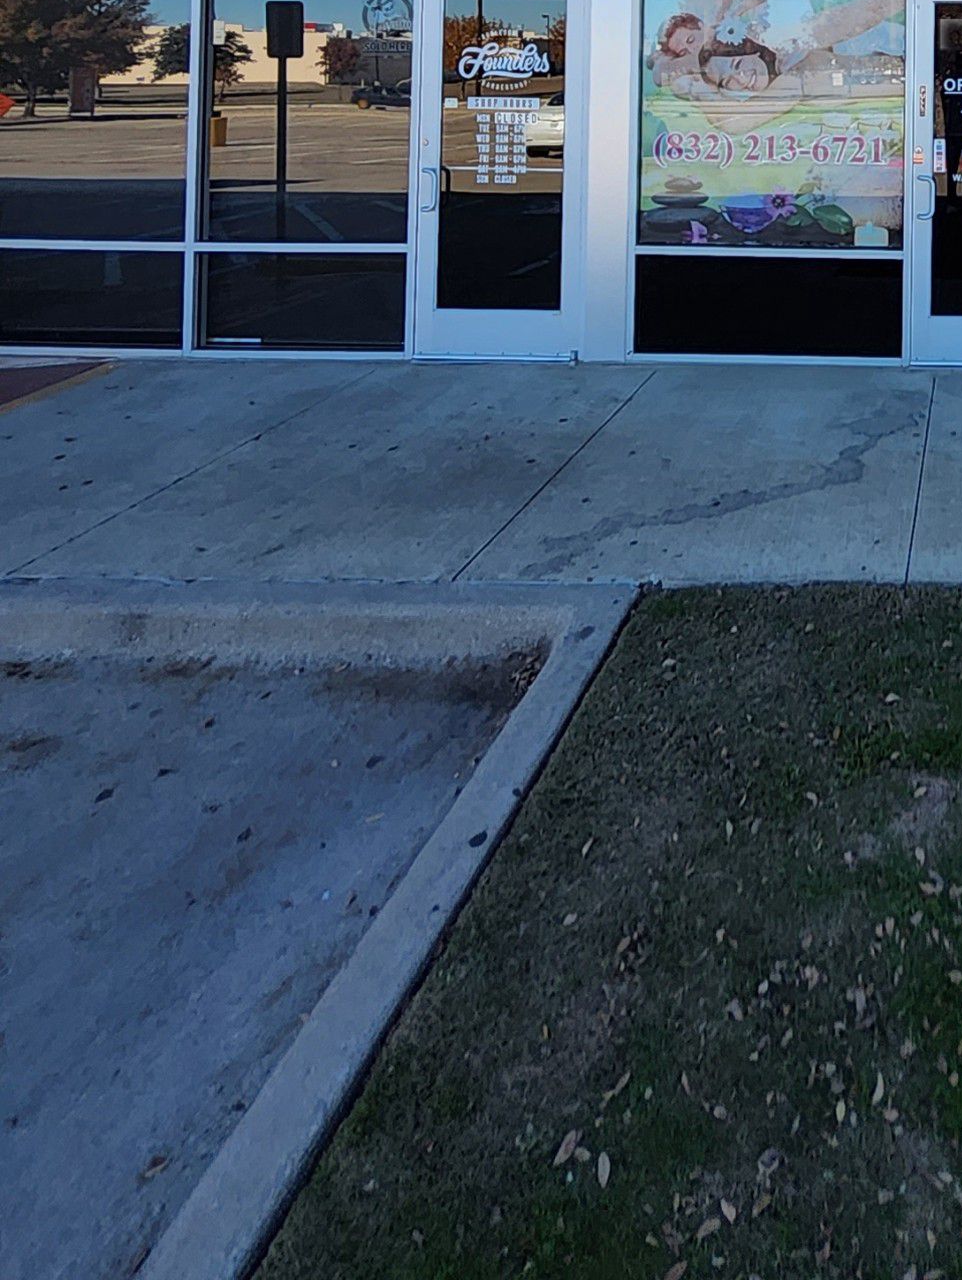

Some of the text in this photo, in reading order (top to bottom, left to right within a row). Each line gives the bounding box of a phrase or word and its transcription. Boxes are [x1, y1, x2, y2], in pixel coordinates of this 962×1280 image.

[458, 42, 550, 79] Founders
[503, 99, 533, 109] HOURS
[496, 113, 537, 124] CLOSED
[653, 131, 888, 169] (832) 213-6721
